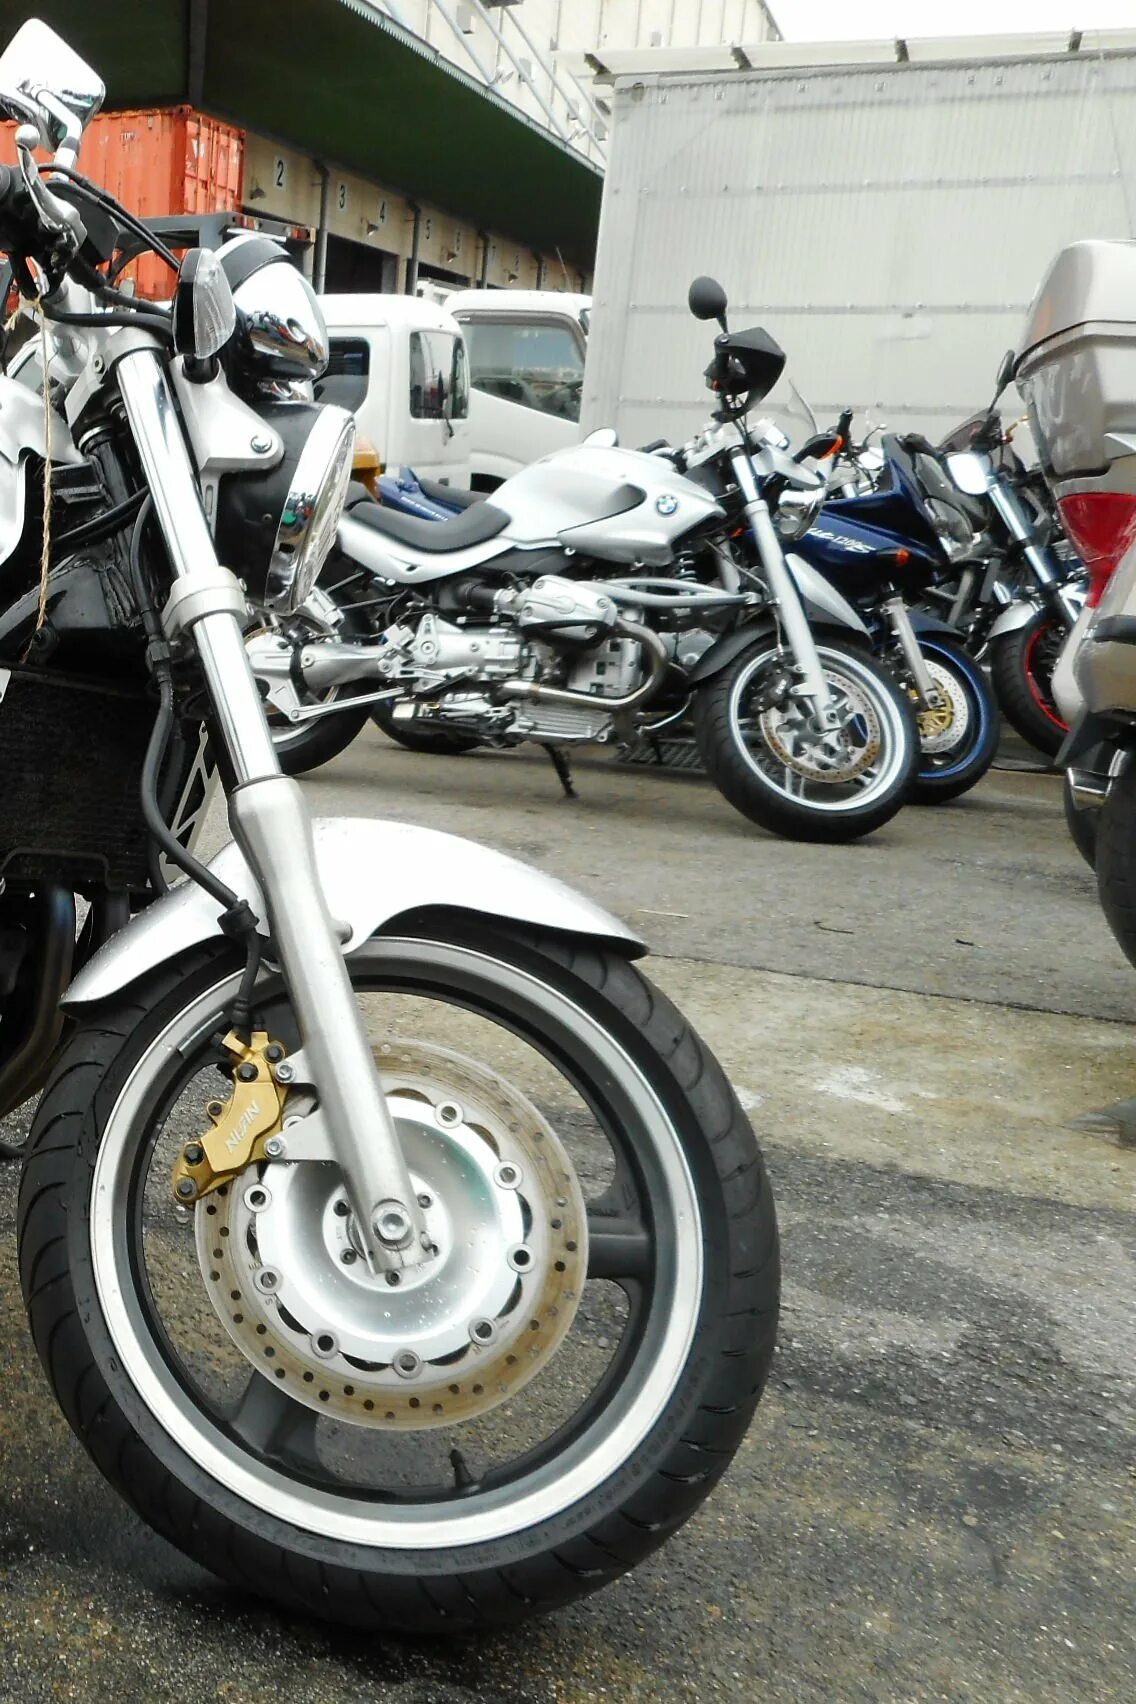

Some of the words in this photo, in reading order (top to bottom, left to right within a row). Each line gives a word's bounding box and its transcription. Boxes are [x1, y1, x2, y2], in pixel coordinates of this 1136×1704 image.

[276, 159, 284, 188] 2
[339, 184, 346, 209] 3
[379, 200, 386, 223] 4
